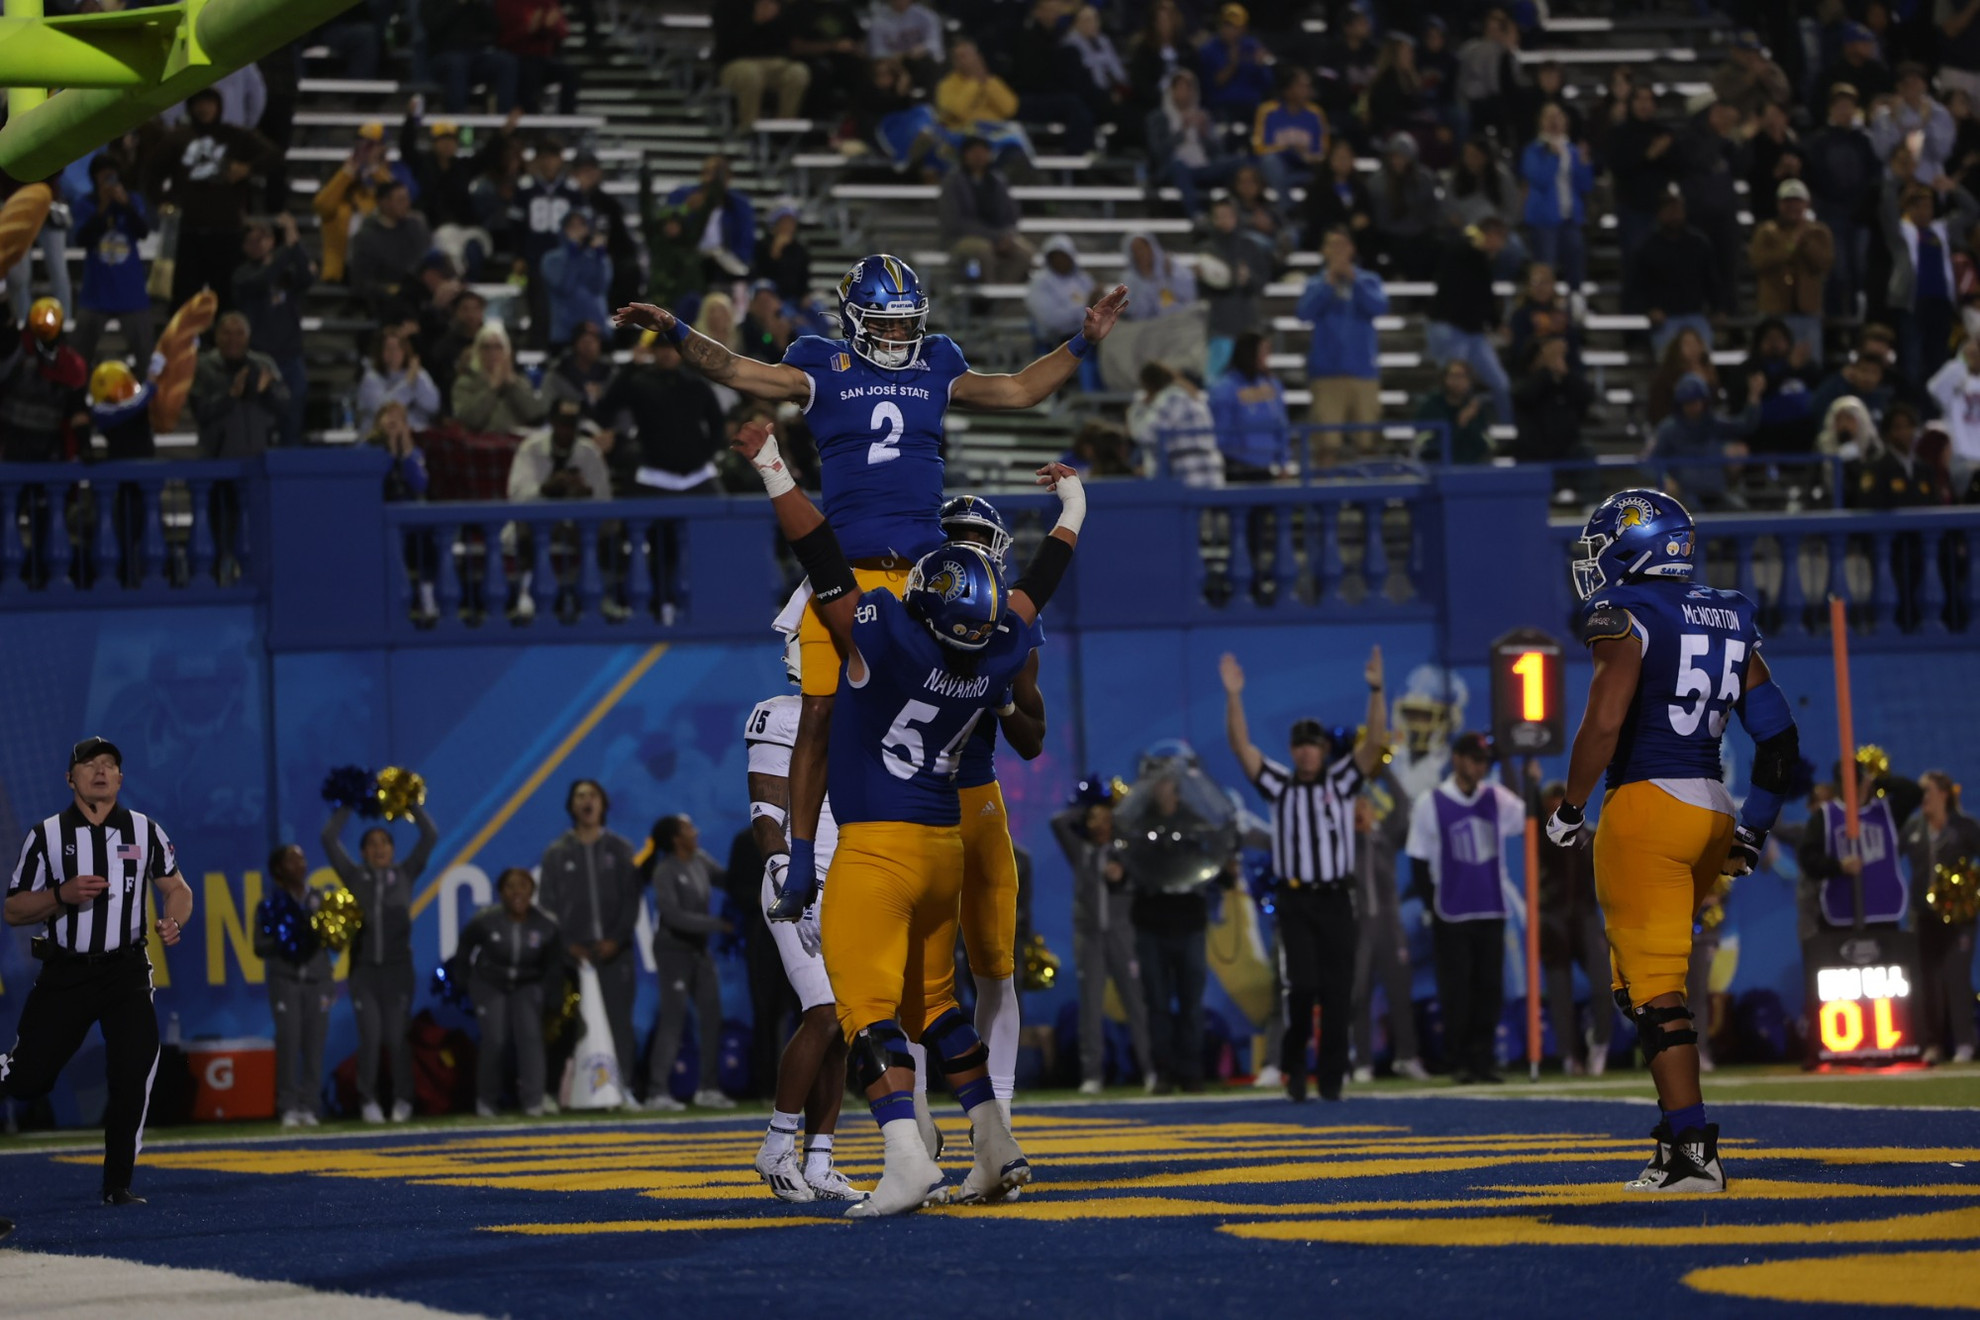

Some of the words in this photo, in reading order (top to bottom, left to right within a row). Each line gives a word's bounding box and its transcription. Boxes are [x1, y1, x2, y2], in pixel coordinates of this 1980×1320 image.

[840, 386, 864, 400] SAN
[866, 383, 896, 396] JOSÉ
[899, 386, 930, 400] STATE
[867, 400, 905, 465] 2
[1681, 603, 1741, 632] McNORTON
[923, 667, 990, 699] NAVARRO
[1512, 652, 1544, 721] 1
[1667, 633, 1746, 739] 55
[748, 709, 771, 734] 15
[880, 698, 987, 783] 54
[65, 843, 76, 856] S
[124, 876, 135, 893] F
[205, 1055, 235, 1091] G
[1679, 1143, 1707, 1168] adidas
